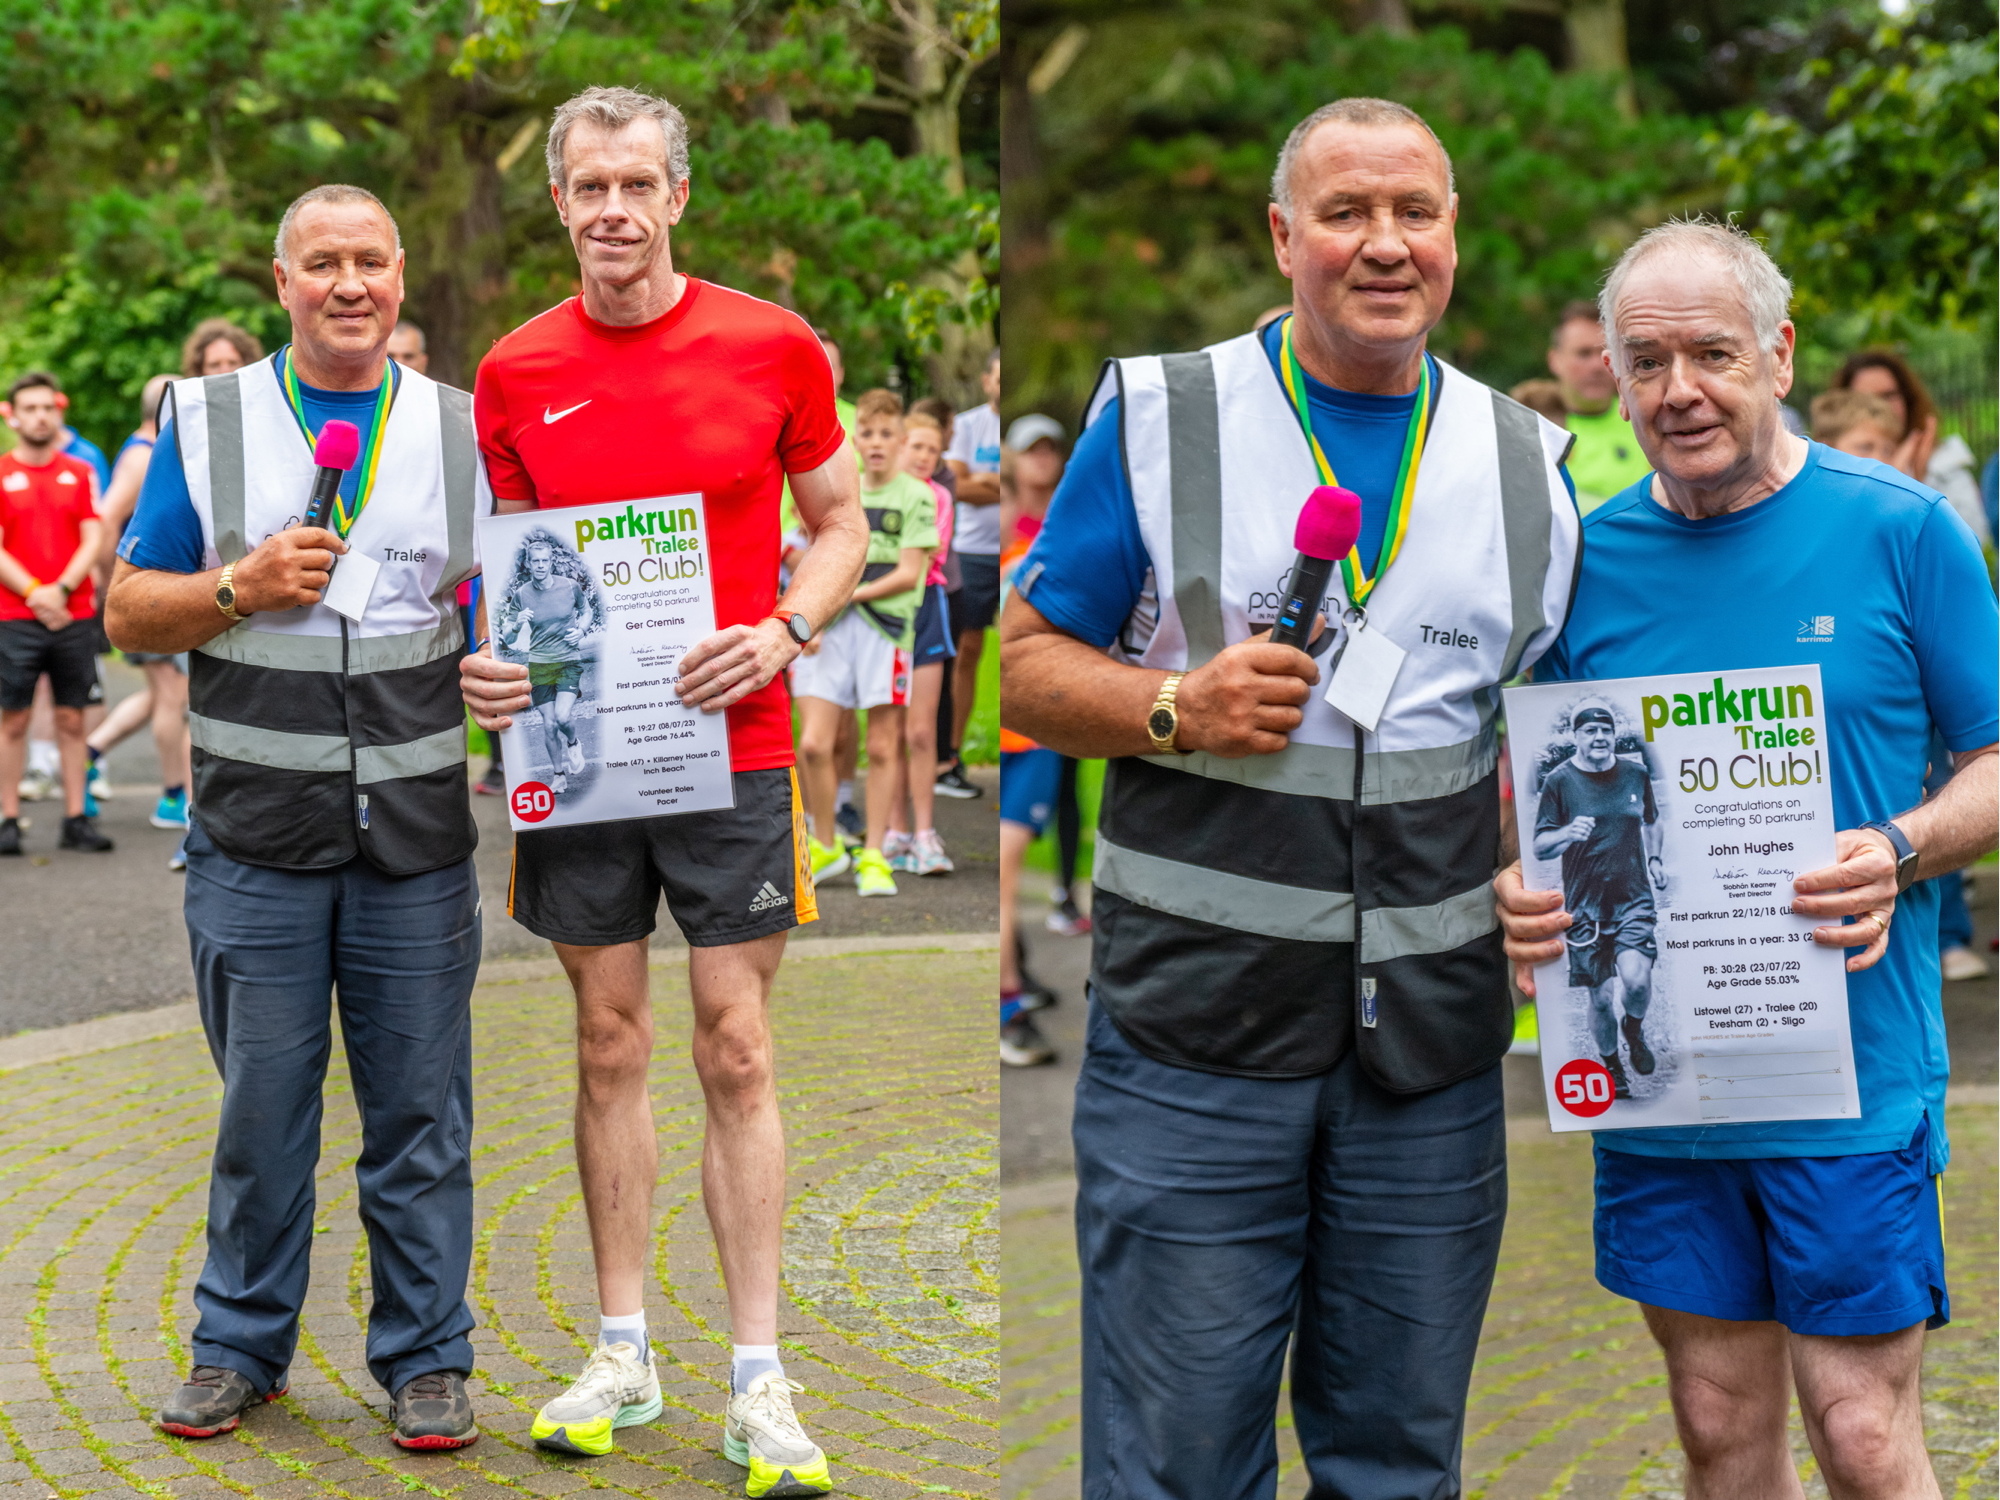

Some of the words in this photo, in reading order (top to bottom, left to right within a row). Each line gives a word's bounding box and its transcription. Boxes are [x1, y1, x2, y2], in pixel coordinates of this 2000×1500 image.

[575, 505, 697, 553] parkrun
[641, 535, 699, 555] Tralee
[603, 561, 631, 587] 50
[638, 553, 704, 582] Club!
[614, 588, 677, 602] Congratulations
[679, 587, 690, 595] on
[606, 600, 652, 613] completing
[653, 599, 663, 607] 50
[665, 595, 700, 607] parkruns!
[626, 621, 643, 630] Ger
[646, 617, 685, 628] Cremins
[1419, 624, 1479, 650] Tralee
[616, 681, 630, 690] First
[632, 678, 660, 689] parkrun
[596, 706, 614, 714] Most
[616, 702, 647, 713] parkruns
[1641, 677, 1814, 743] parkrun
[638, 724, 656, 732] 19:27
[658, 720, 696, 731] (08/07/23)
[627, 737, 642, 745] Age
[644, 734, 668, 743] Grade
[669, 731, 695, 739] 76.44%
[1734, 722, 1816, 750] Tralee
[630, 758, 645, 766] (47)
[653, 754, 684, 764] Killarney
[686, 752, 708, 760] House
[643, 767, 660, 775] Inch
[662, 765, 685, 773] Beach
[1679, 757, 1719, 793] 50
[1729, 750, 1822, 789] Club!
[638, 787, 673, 797] Volunteer
[675, 785, 694, 793] Roles
[516, 790, 551, 814] 50
[657, 798, 678, 806] Pacer
[1694, 800, 1783, 814] Congratulations
[1786, 799, 1801, 808] on
[1682, 815, 1746, 829] completing
[1749, 814, 1762, 824] 50
[1765, 811, 1815, 825] parkruns!
[1708, 844, 1740, 857] John
[1744, 841, 1794, 856] Hughes
[1750, 881, 1777, 889] Kearney
[749, 896, 789, 912] adidas
[1670, 912, 1688, 922] First
[1691, 910, 1729, 922] parkrun
[1732, 907, 1776, 919] 22/12/18
[1666, 940, 1689, 950] Most
[1692, 937, 1735, 950] parkruns
[1737, 936, 1747, 945] in
[1759, 935, 1785, 946] year:
[1787, 933, 1800, 942] 33
[1703, 966, 1718, 975] PB:
[1721, 964, 1747, 974] 30:28
[1750, 961, 1801, 973] (23/07/22)
[1707, 978, 1727, 990] Age
[1730, 976, 1762, 987] Grade
[1764, 975, 1800, 986] 55.03%
[1694, 1005, 1731, 1016] Listowel
[1734, 1004, 1753, 1015] (27)
[1765, 1003, 1796, 1013] Tralee
[1799, 1001, 1818, 1012] (20)
[1709, 1018, 1753, 1029] Evesham
[1756, 1017, 1769, 1028] (2)
[1781, 1016, 1805, 1027] Sligo
[1562, 1073, 1610, 1104] 50
